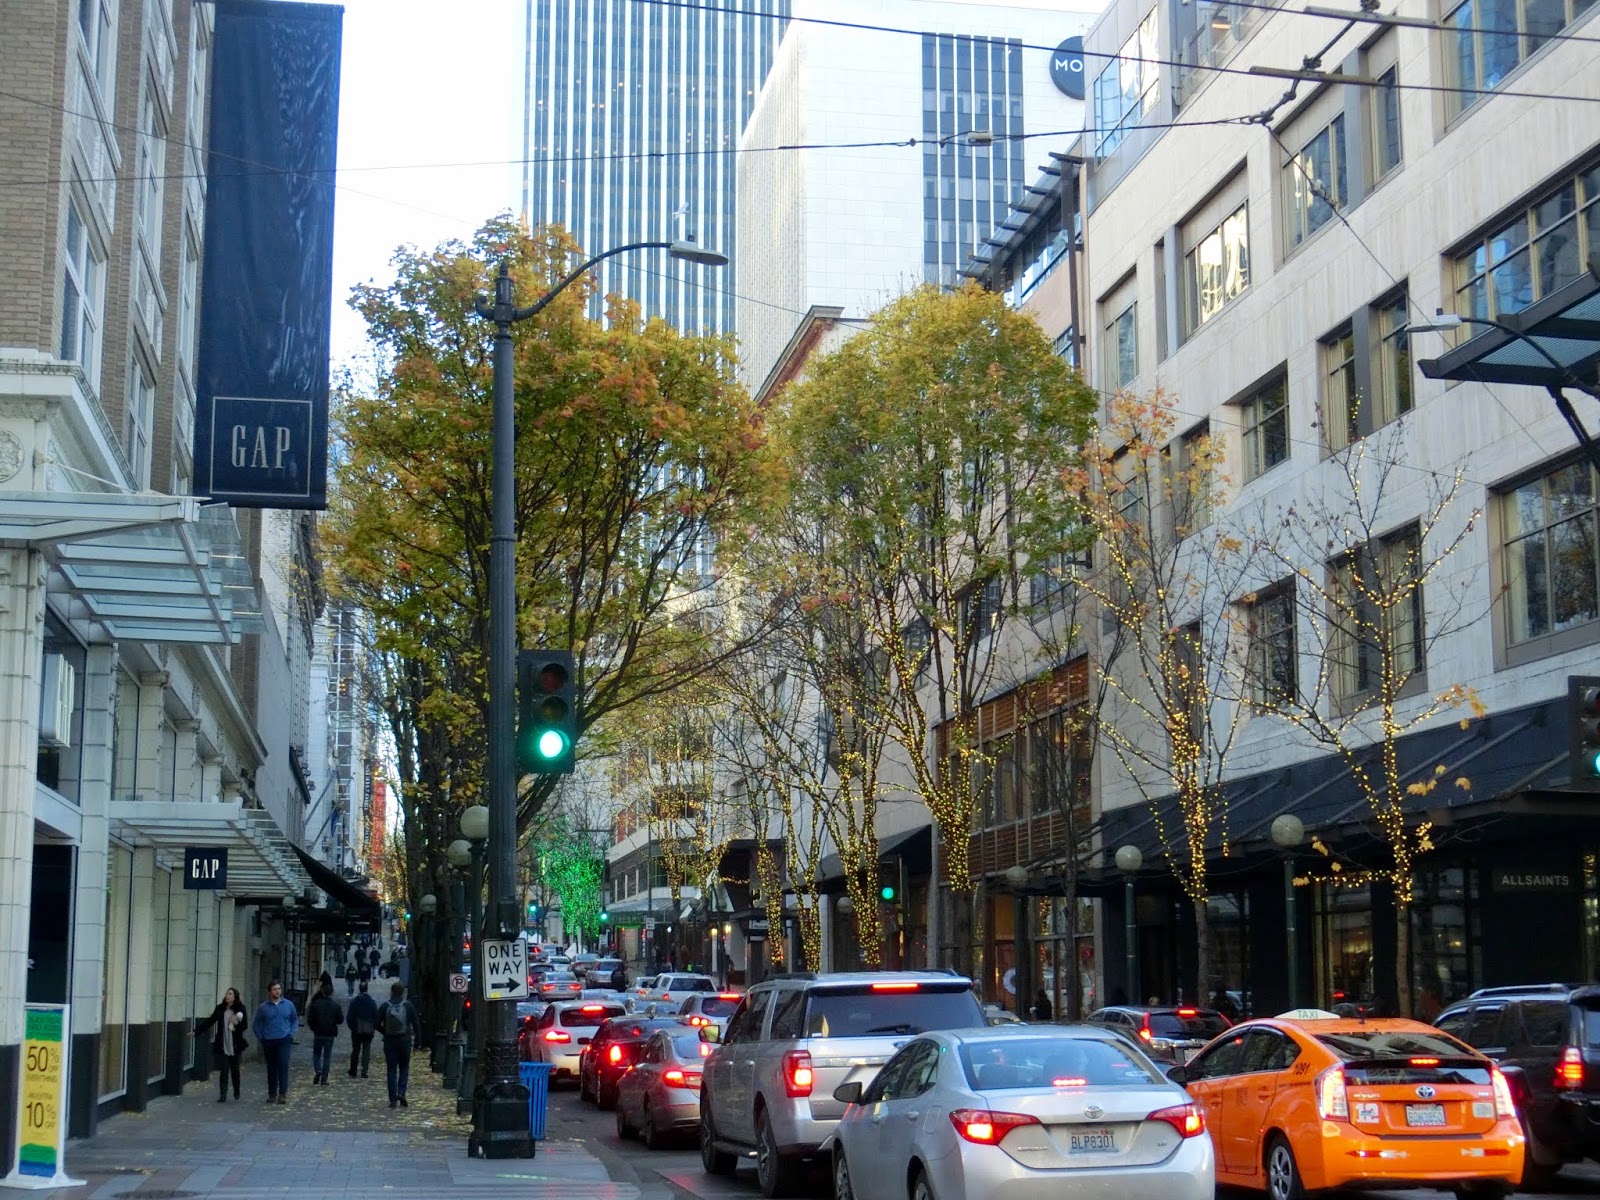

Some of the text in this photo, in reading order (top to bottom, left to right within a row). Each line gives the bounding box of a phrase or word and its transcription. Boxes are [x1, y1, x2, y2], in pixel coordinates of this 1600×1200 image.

[231, 424, 291, 469] GAP
[192, 858, 220, 879] GAP
[1501, 875, 1569, 886] ALLSAINTS
[488, 944, 521, 959] ONE
[488, 960, 523, 976] WAY
[1297, 1010, 1319, 1019] TAXI
[1071, 1135, 1115, 1149] BLP8301
